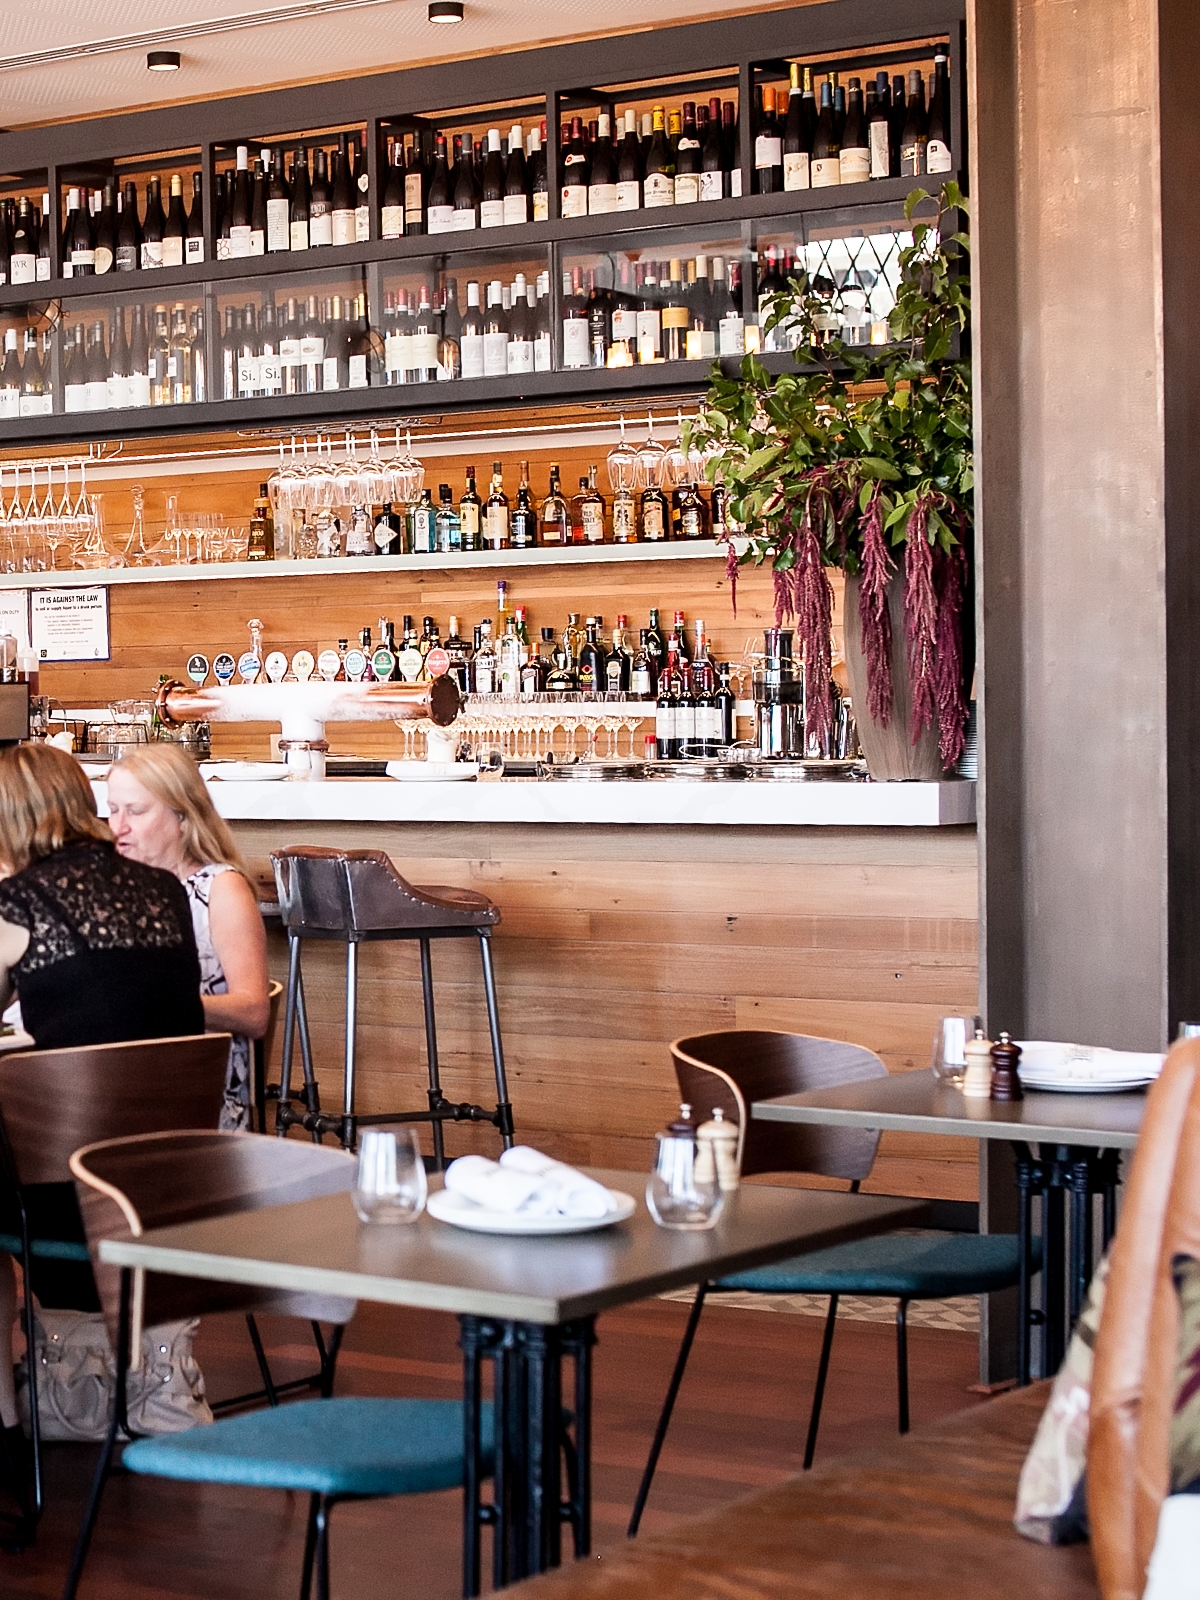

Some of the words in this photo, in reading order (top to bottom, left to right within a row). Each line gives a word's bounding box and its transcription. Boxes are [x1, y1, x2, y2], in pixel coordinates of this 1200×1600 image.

[241, 369, 256, 381] Si.
[265, 367, 280, 379] Si.
[45, 596, 52, 604] IS
[52, 595, 75, 603] AGAINST
[75, 594, 86, 602] THE
